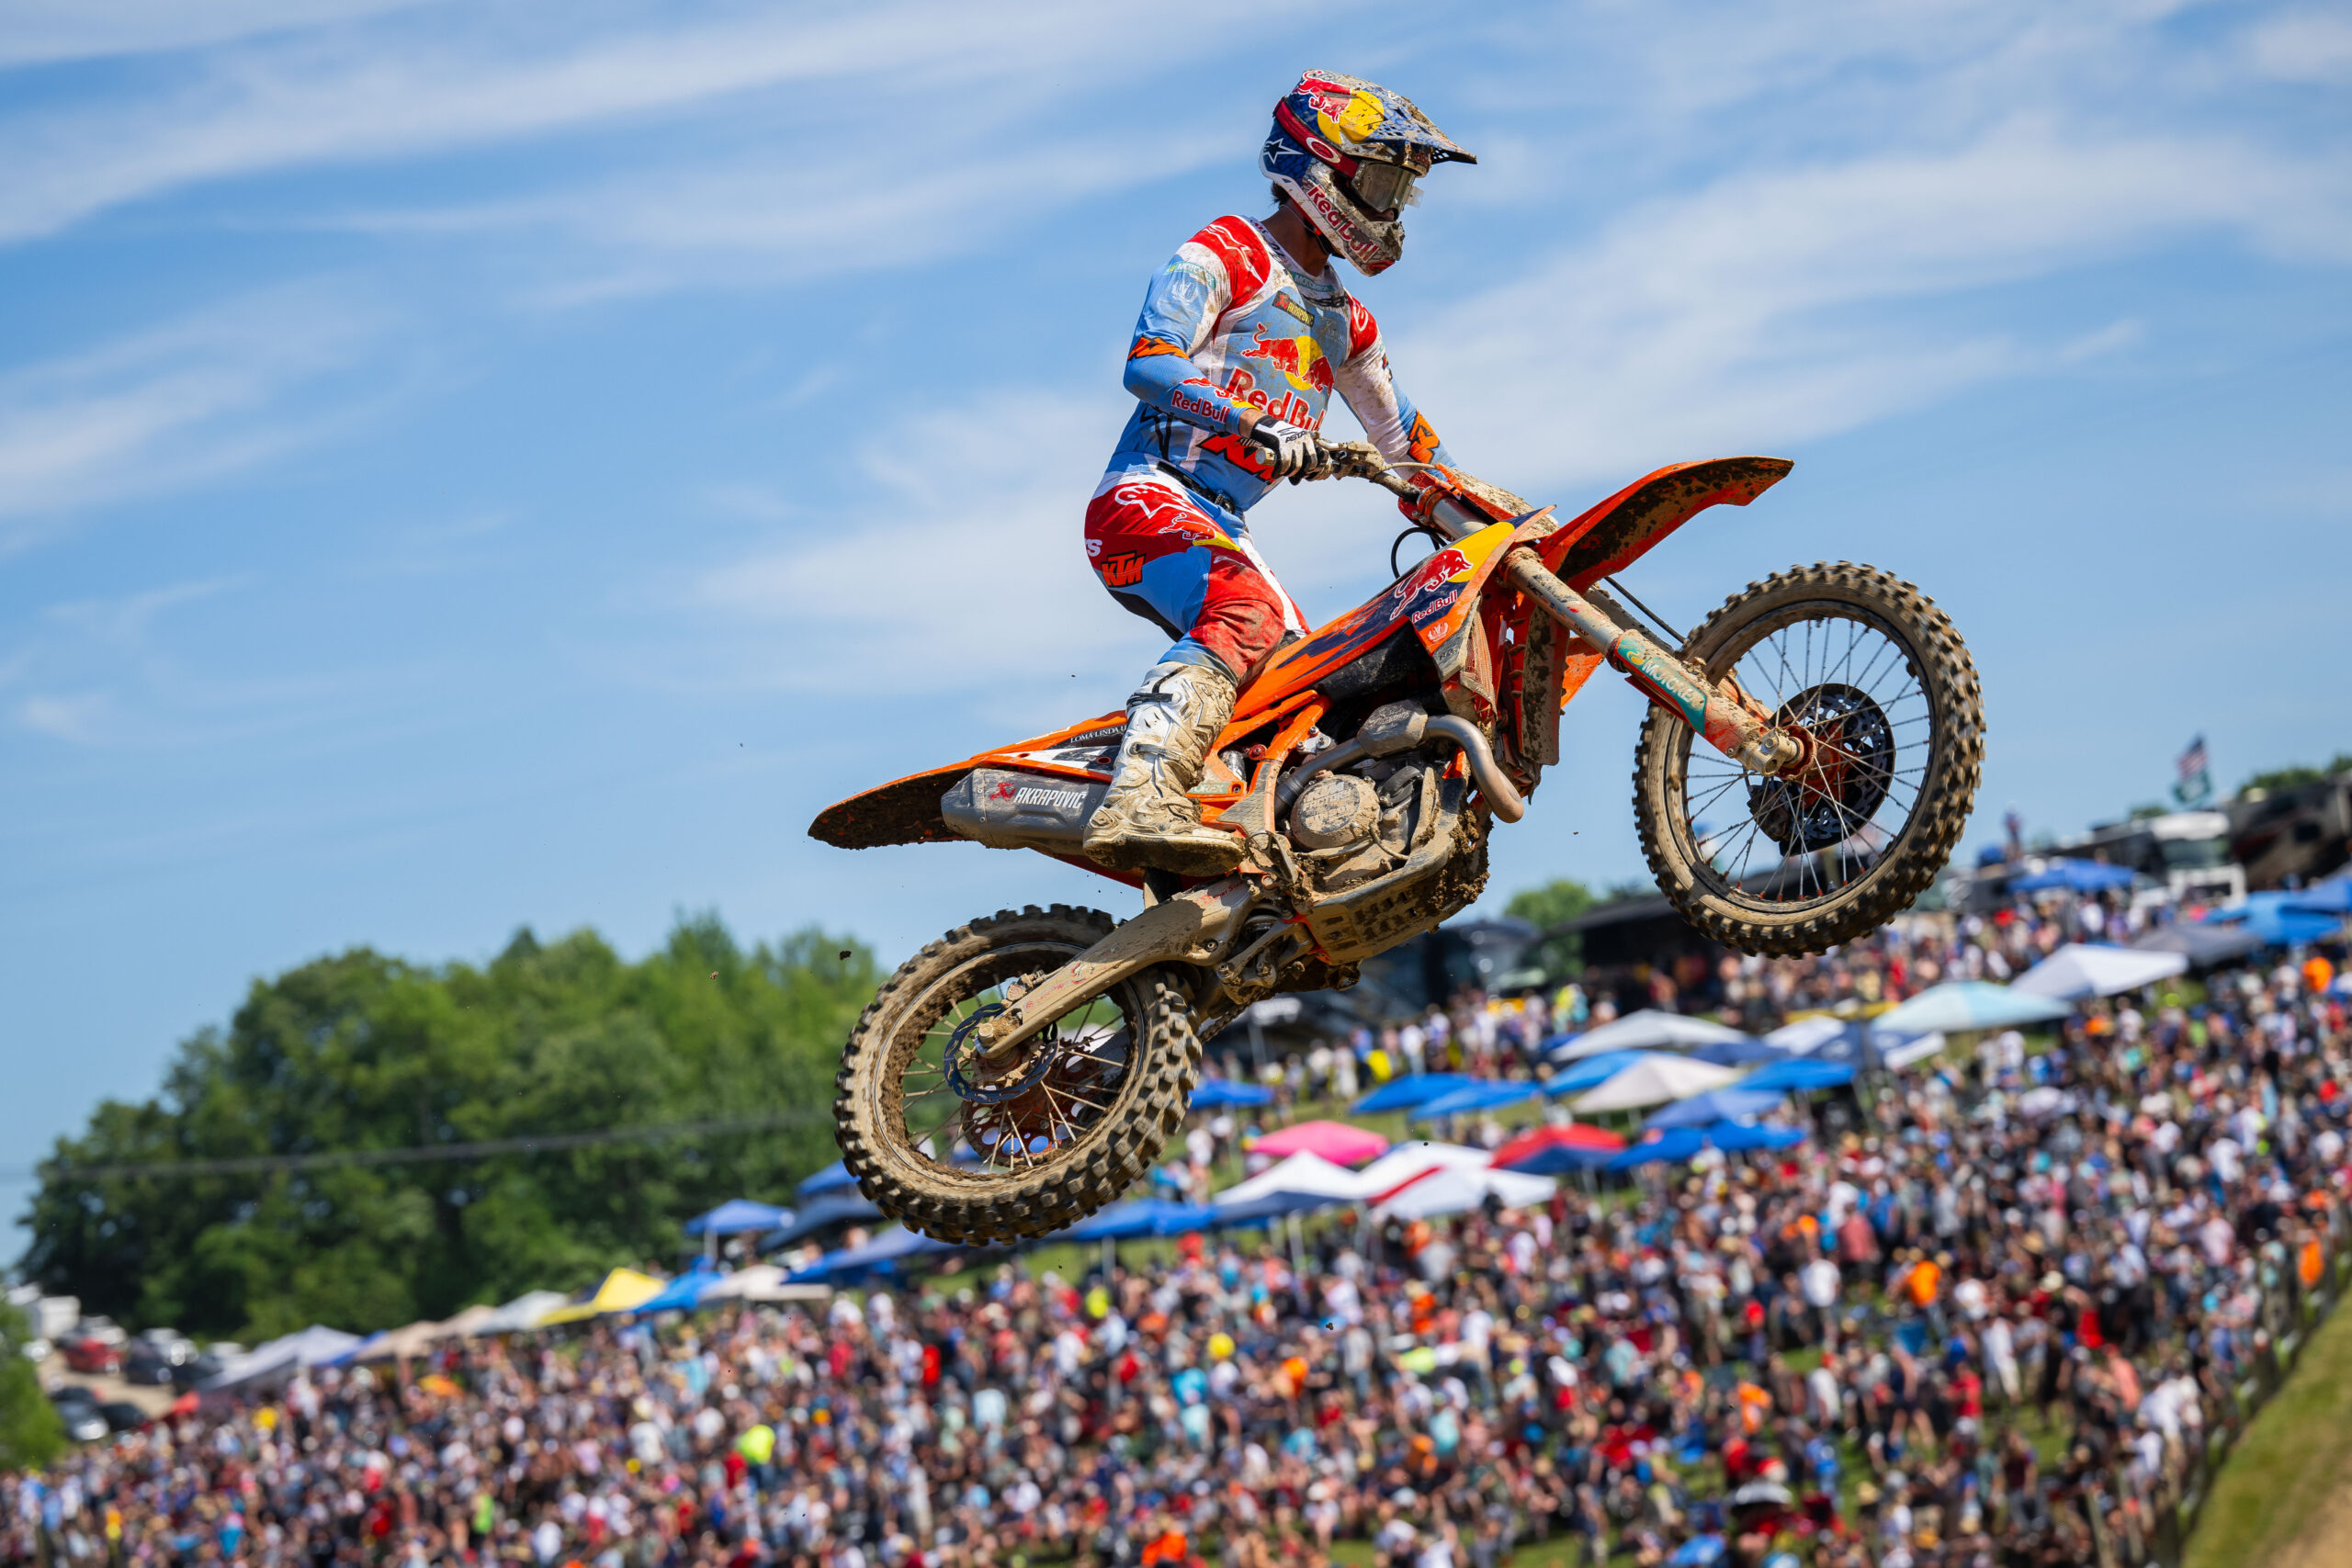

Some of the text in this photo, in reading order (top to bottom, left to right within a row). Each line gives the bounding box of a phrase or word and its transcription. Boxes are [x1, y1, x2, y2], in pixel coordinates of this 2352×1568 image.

[1170, 389, 1231, 423] Red Bull
[1226, 367, 1293, 422] Red
[1101, 550, 1147, 588] KTM
[1411, 589, 1458, 623] Red Bull
[1070, 732, 1093, 743] LOMA
[1094, 727, 1119, 738] LINDA
[1013, 786, 1088, 808] AKRAPOVIČ
